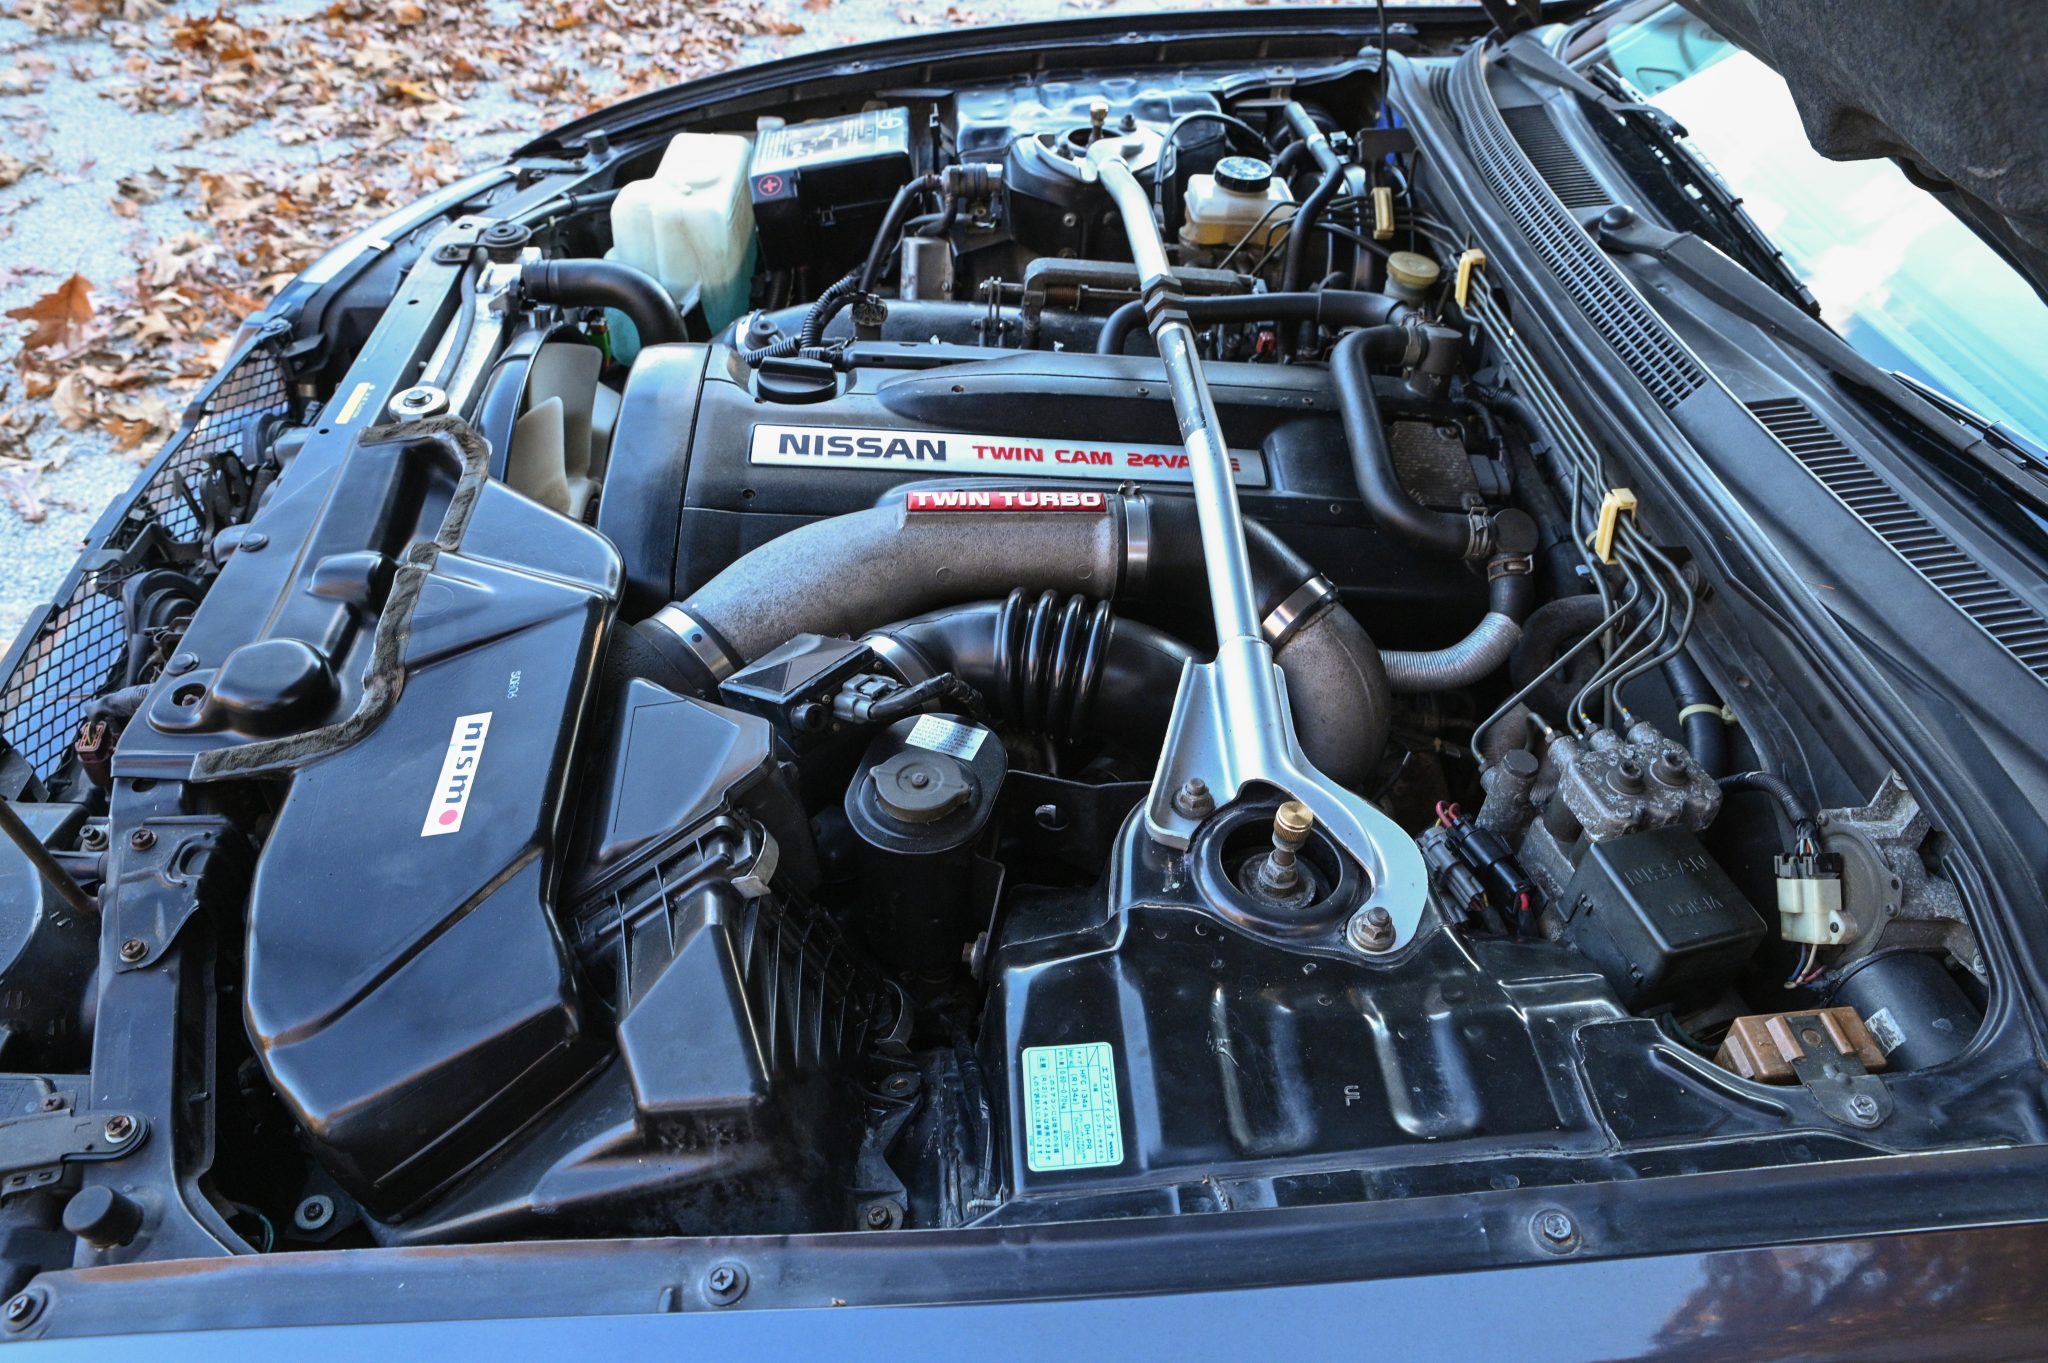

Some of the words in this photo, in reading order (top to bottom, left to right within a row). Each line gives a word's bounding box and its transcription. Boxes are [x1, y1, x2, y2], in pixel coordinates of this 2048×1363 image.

[779, 433, 946, 461] NISSAN
[972, 445, 1043, 462] TWIN
[1055, 449, 1113, 465] CAM
[1127, 453, 1240, 472] 24VAE
[912, 492, 990, 507] TWIN
[999, 492, 1101, 507] TURBO
[1624, 855, 1709, 886] NISSAN
